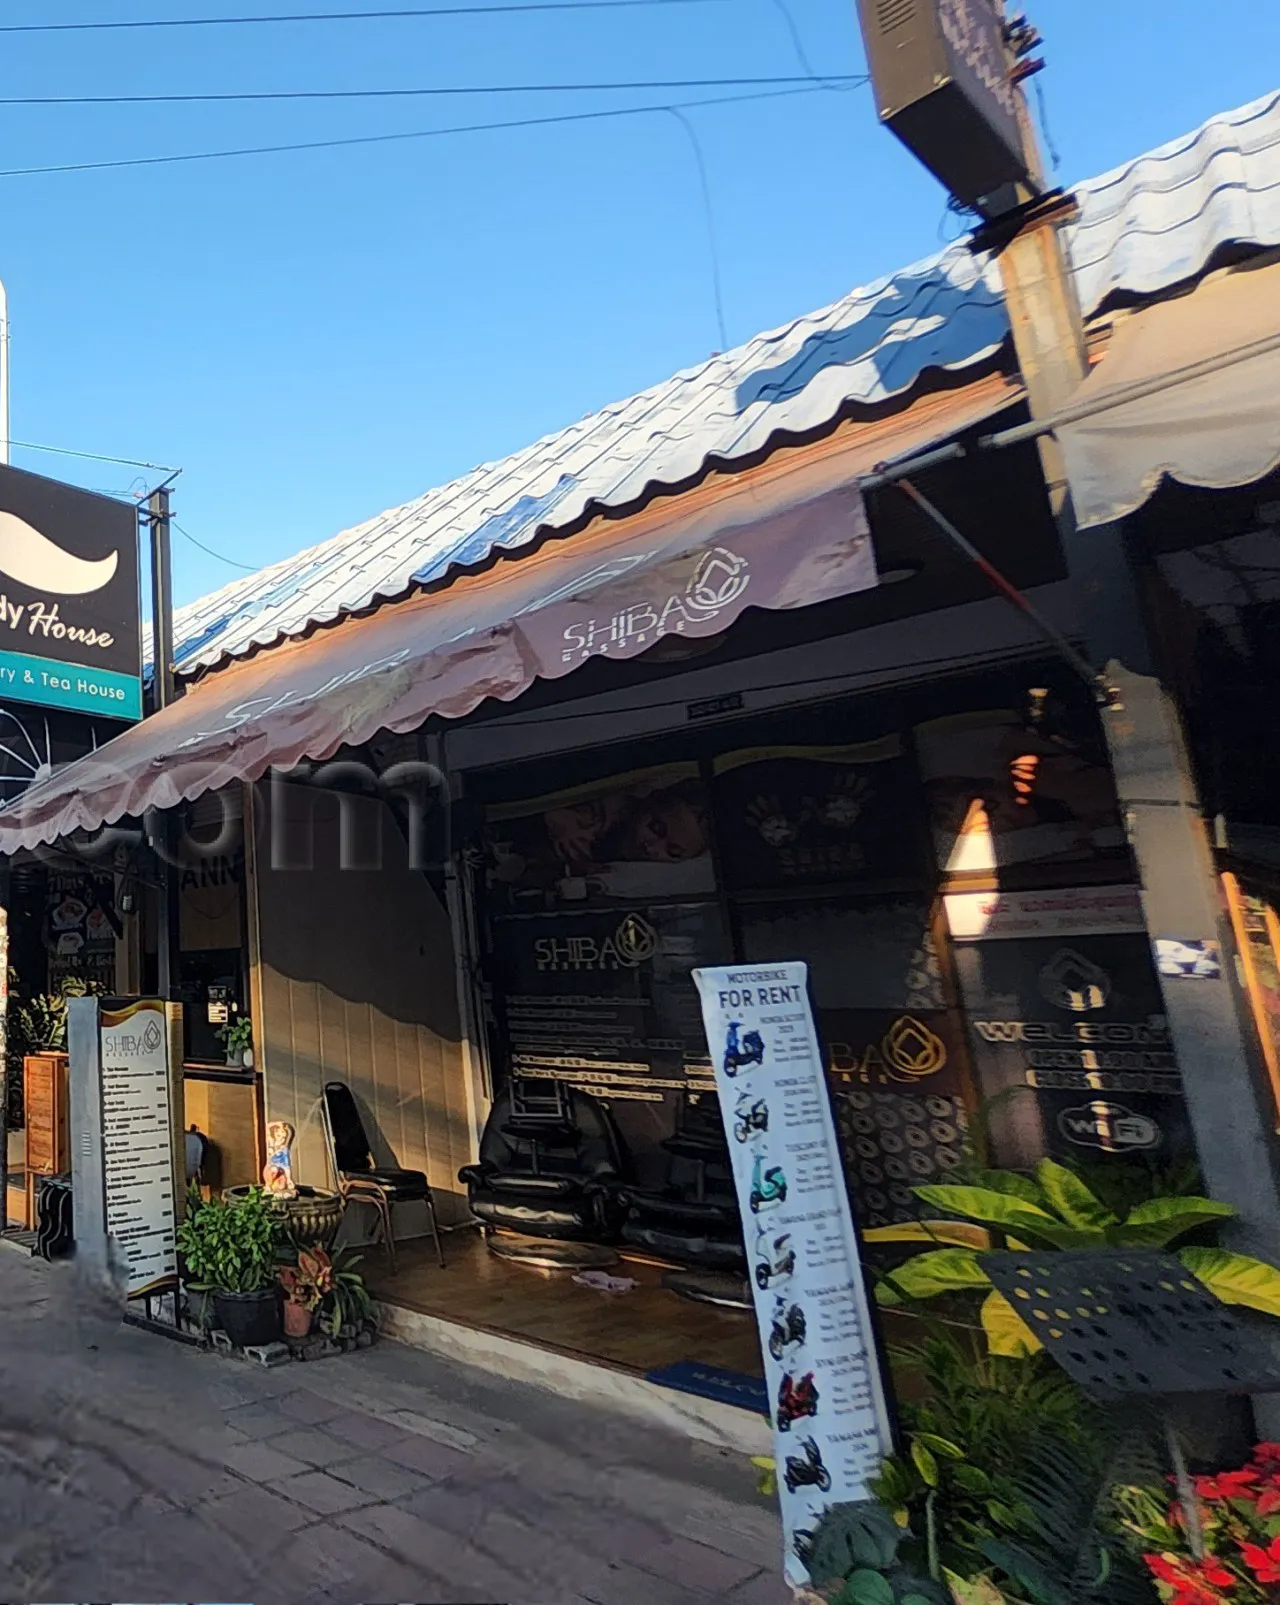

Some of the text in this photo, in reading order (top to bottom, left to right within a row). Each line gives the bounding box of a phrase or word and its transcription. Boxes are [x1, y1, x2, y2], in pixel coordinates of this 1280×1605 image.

[27, 601, 115, 648] House
[23, 668, 35, 684] &
[41, 671, 71, 691] Tea
[77, 678, 126, 701] House
[534, 936, 625, 966] SHIBA
[726, 969, 788, 984] MOTORBIKE
[718, 984, 802, 1009] FOR RENT
